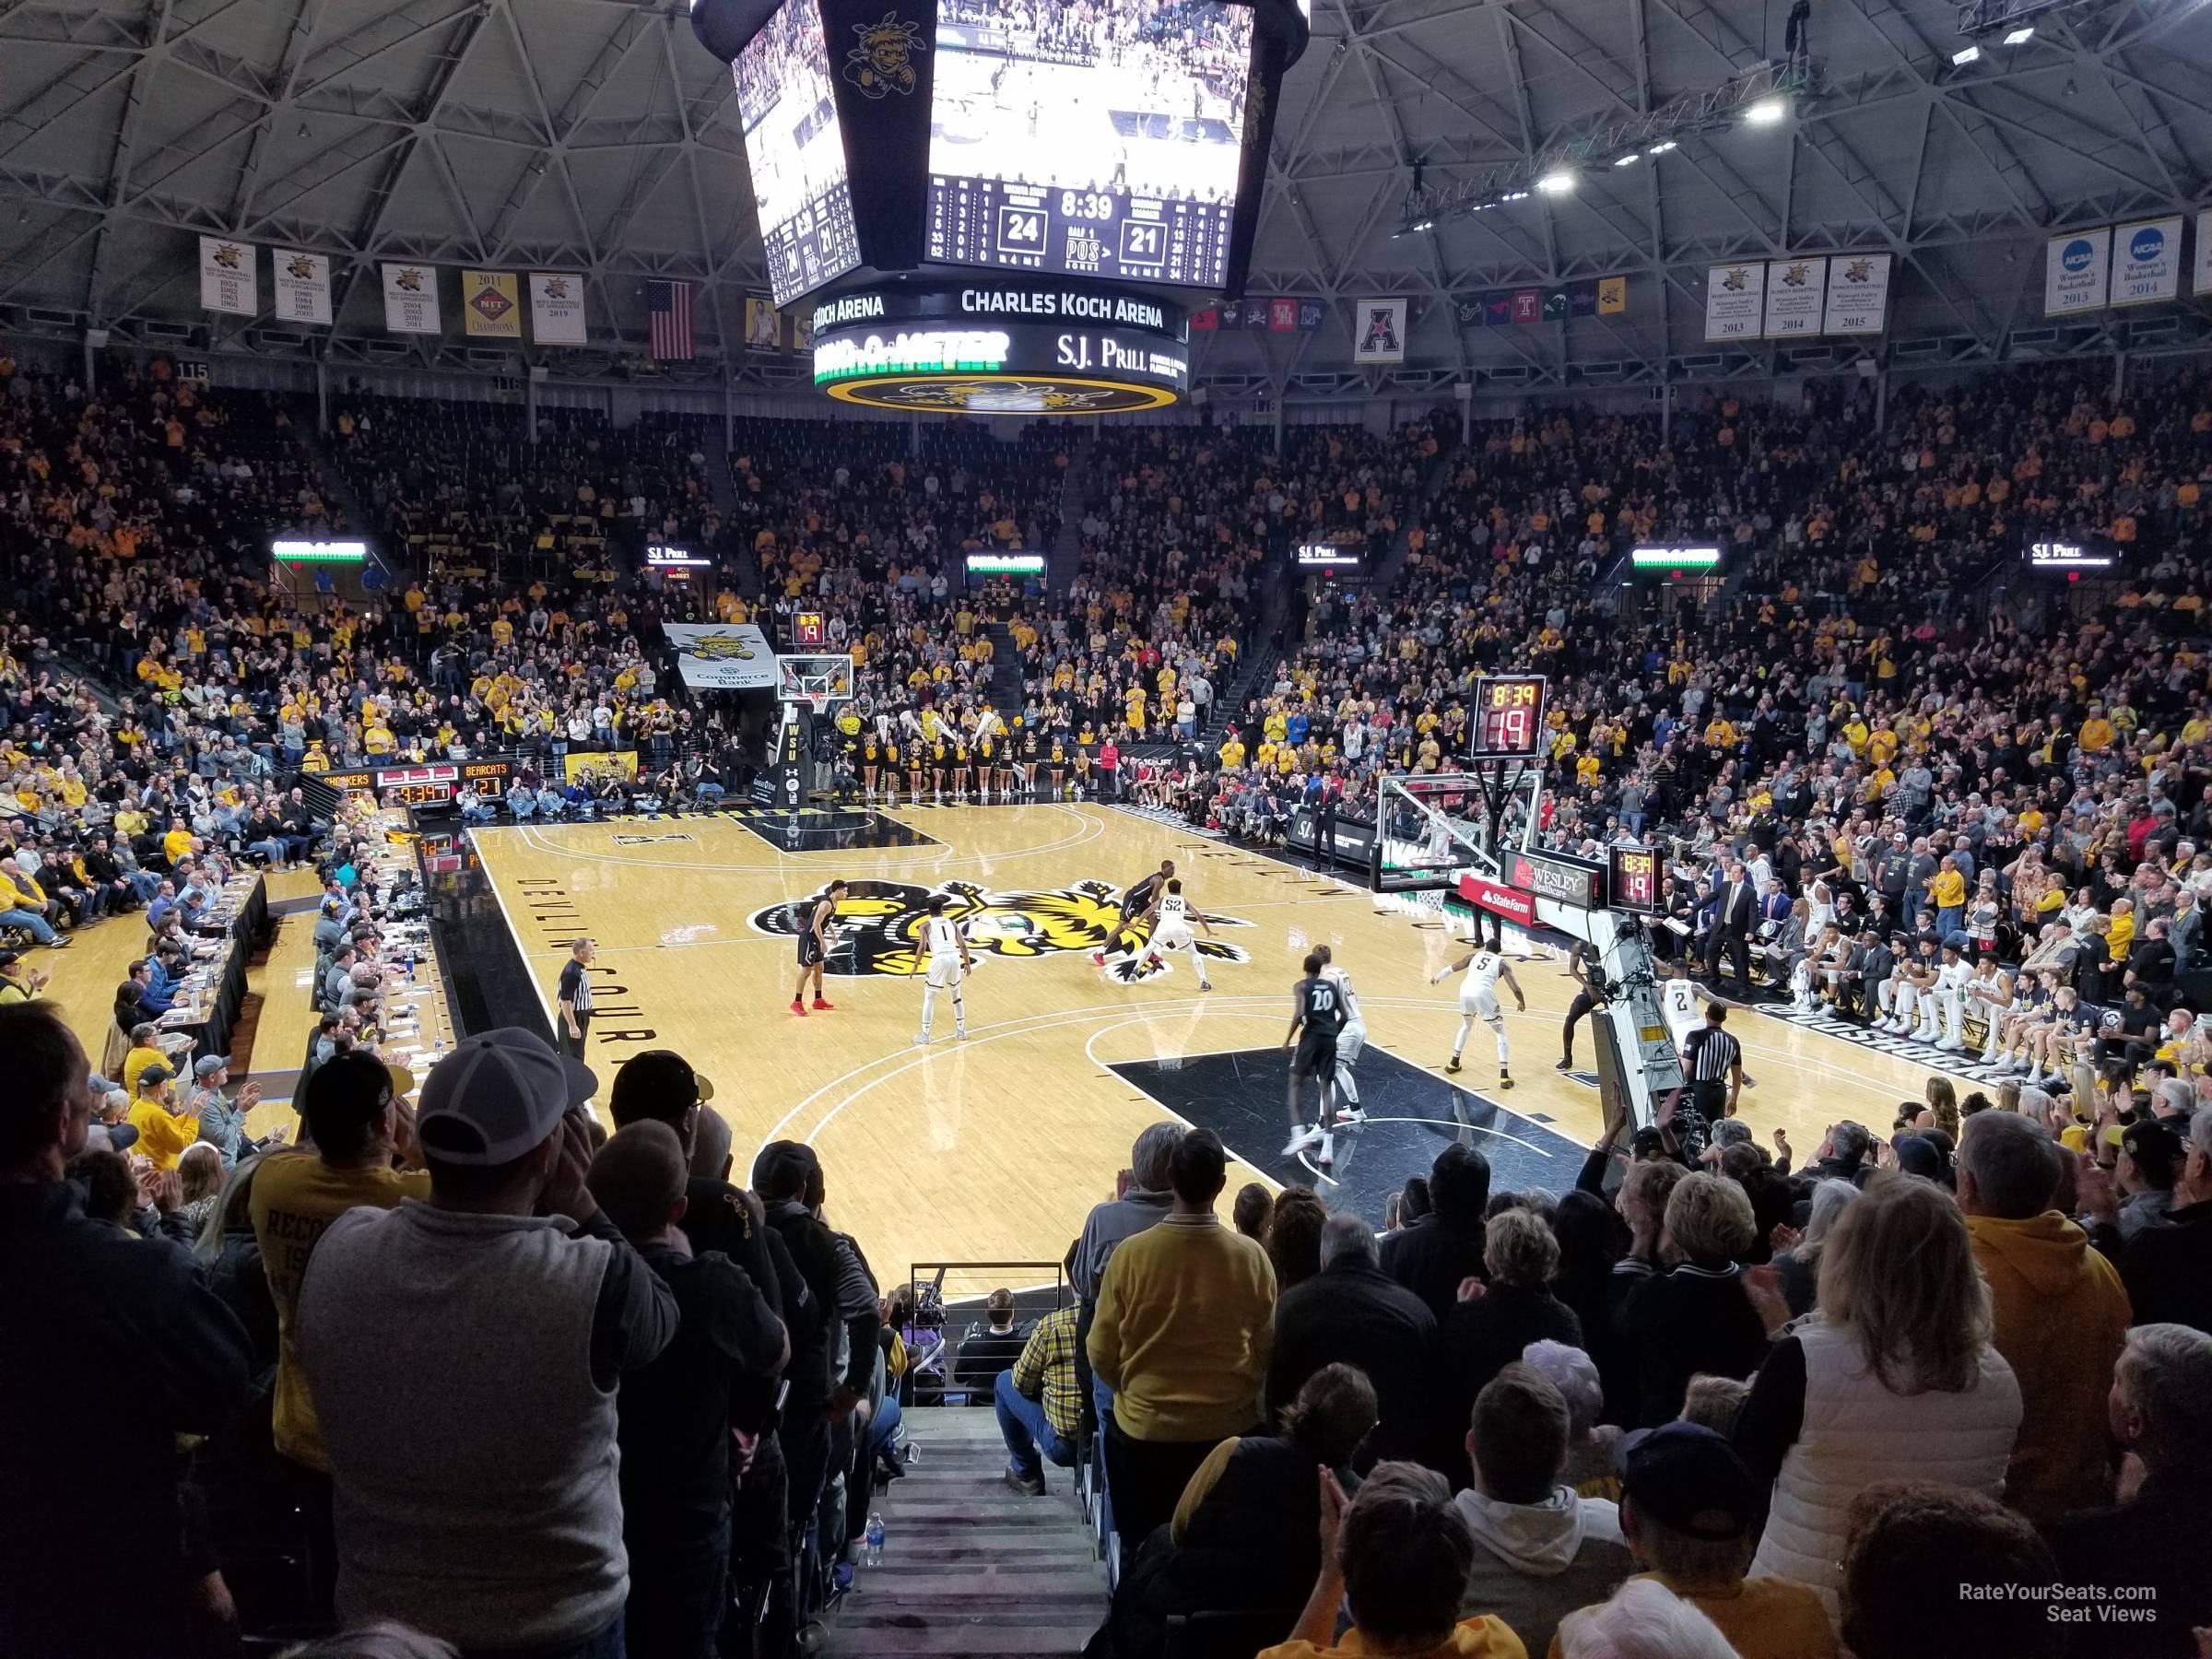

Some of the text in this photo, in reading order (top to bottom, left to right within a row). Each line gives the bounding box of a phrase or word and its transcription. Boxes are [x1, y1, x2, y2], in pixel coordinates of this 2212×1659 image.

[936, 190, 943, 202] 1
[983, 195, 989, 206] 1
[1062, 191, 1112, 220] 8:39
[935, 205, 988, 220] 2 3 1
[982, 223, 988, 234] 1
[1007, 214, 1038, 241] 24
[1177, 216, 1183, 228] 2
[1218, 220, 1225, 232] 0
[957, 234, 965, 245] 0
[981, 237, 987, 248] 1
[1088, 228, 1095, 239] 1
[1129, 227, 1157, 253] 21
[1218, 234, 1224, 245] 0
[956, 247, 964, 259] 0
[980, 250, 987, 262] 0
[1066, 240, 1100, 261] POS
[1195, 244, 1202, 255] 0
[1216, 246, 1222, 258] 0
[2133, 242, 2162, 254] NCAA
[1215, 259, 1221, 270] 0
[2065, 253, 2094, 265] NCAA
[2127, 260, 2166, 272] Women's
[478, 275, 501, 287] 2011
[1214, 272, 1219, 283] 1
[2059, 271, 2095, 282] Women's
[2124, 269, 2167, 281] Basketball
[2057, 279, 2096, 291] Basketball
[2130, 282, 2158, 295] 2014
[479, 300, 502, 309] NIT
[837, 296, 885, 322] ARENA
[961, 289, 1163, 328] CHARLES KOCH ARENA
[472, 320, 514, 333] CHAMPIONS
[1723, 324, 1744, 333] 2013
[1782, 320, 1804, 330] 2014
[1842, 317, 1865, 327] 2015
[1057, 335, 1092, 369] S.J.
[1101, 338, 1147, 371] PRILL
[178, 360, 207, 379] 115
[800, 615, 820, 626] 8:39
[805, 626, 818, 641] 19
[1494, 686, 1534, 707] 8:39
[1499, 711, 1524, 746] 19
[788, 724, 799, 761] WSU
[466, 764, 507, 776] BEARCATS
[480, 780, 498, 795] 21
[1176, 843, 1355, 896] DEVLIN
[1625, 855, 1652, 874] 8:39
[1534, 867, 1577, 892] WESLEY
[1533, 881, 1567, 899] Healthcare
[1630, 877, 1646, 899] 19
[1165, 899, 1182, 912] 52
[517, 879, 599, 948] DEVLIN
[941, 925, 947, 941] 1
[1477, 957, 1491, 971] 5
[1312, 989, 1334, 1011] 20
[1675, 993, 1688, 1012] 2
